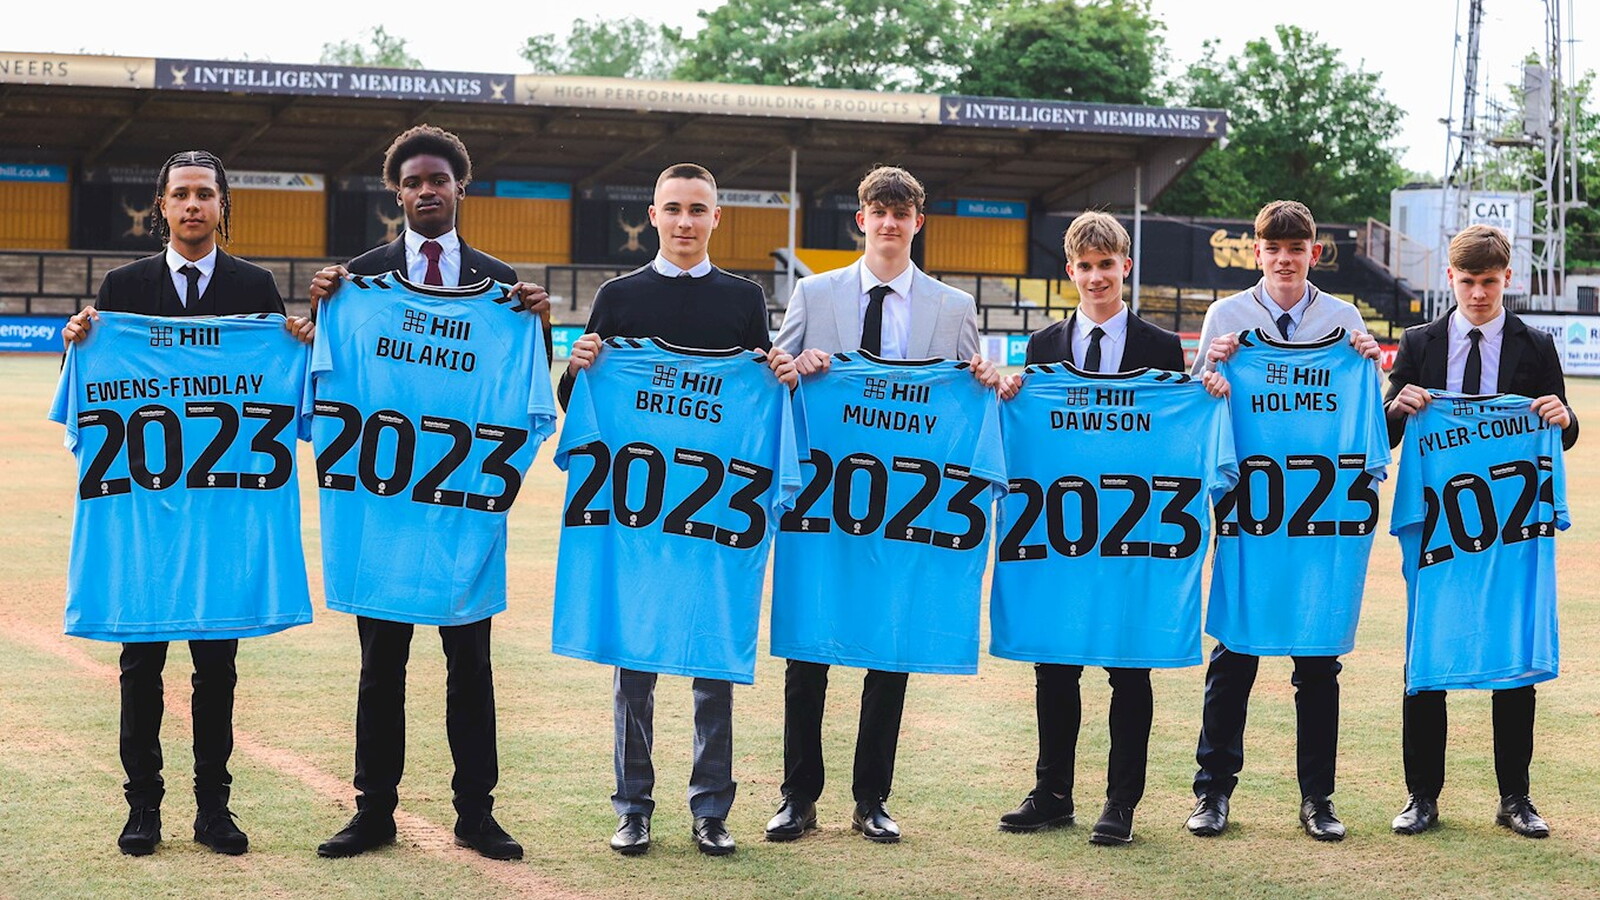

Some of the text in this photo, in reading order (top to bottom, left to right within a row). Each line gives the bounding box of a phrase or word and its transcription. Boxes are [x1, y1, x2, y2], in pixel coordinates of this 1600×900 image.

[0, 60, 69, 77] NEERS
[193, 66, 482, 96] INTELLIGENT MEMBRANES
[554, 86, 910, 115] HIGH PERFORMANCE BUILDING PRODUCTS
[965, 103, 1200, 130] INTELLIGENT MEMBRANES
[968, 204, 1012, 215] hill.co.uk
[1475, 203, 1509, 218] CAT
[0, 325, 56, 340] empsey
[180, 328, 220, 346] Hill
[430, 317, 471, 341] Hill
[376, 337, 476, 373] BULAKIO
[86, 374, 264, 403] EWENS-FINDLAY
[681, 371, 723, 396] Hill
[1293, 367, 1330, 387] Hill
[635, 390, 723, 423] BRIGGS
[891, 383, 930, 404] Hill
[1096, 389, 1135, 407] Hill
[1251, 392, 1338, 413] HOLMES
[843, 404, 937, 434] MUNDAY
[1050, 411, 1150, 431] DAWSON
[1419, 414, 1552, 456] TYLER-COWLI
[78, 402, 296, 500] 2023
[314, 400, 528, 513] 2023
[565, 441, 774, 549] 2023
[780, 448, 992, 550] 2023
[999, 475, 1202, 562] 2023
